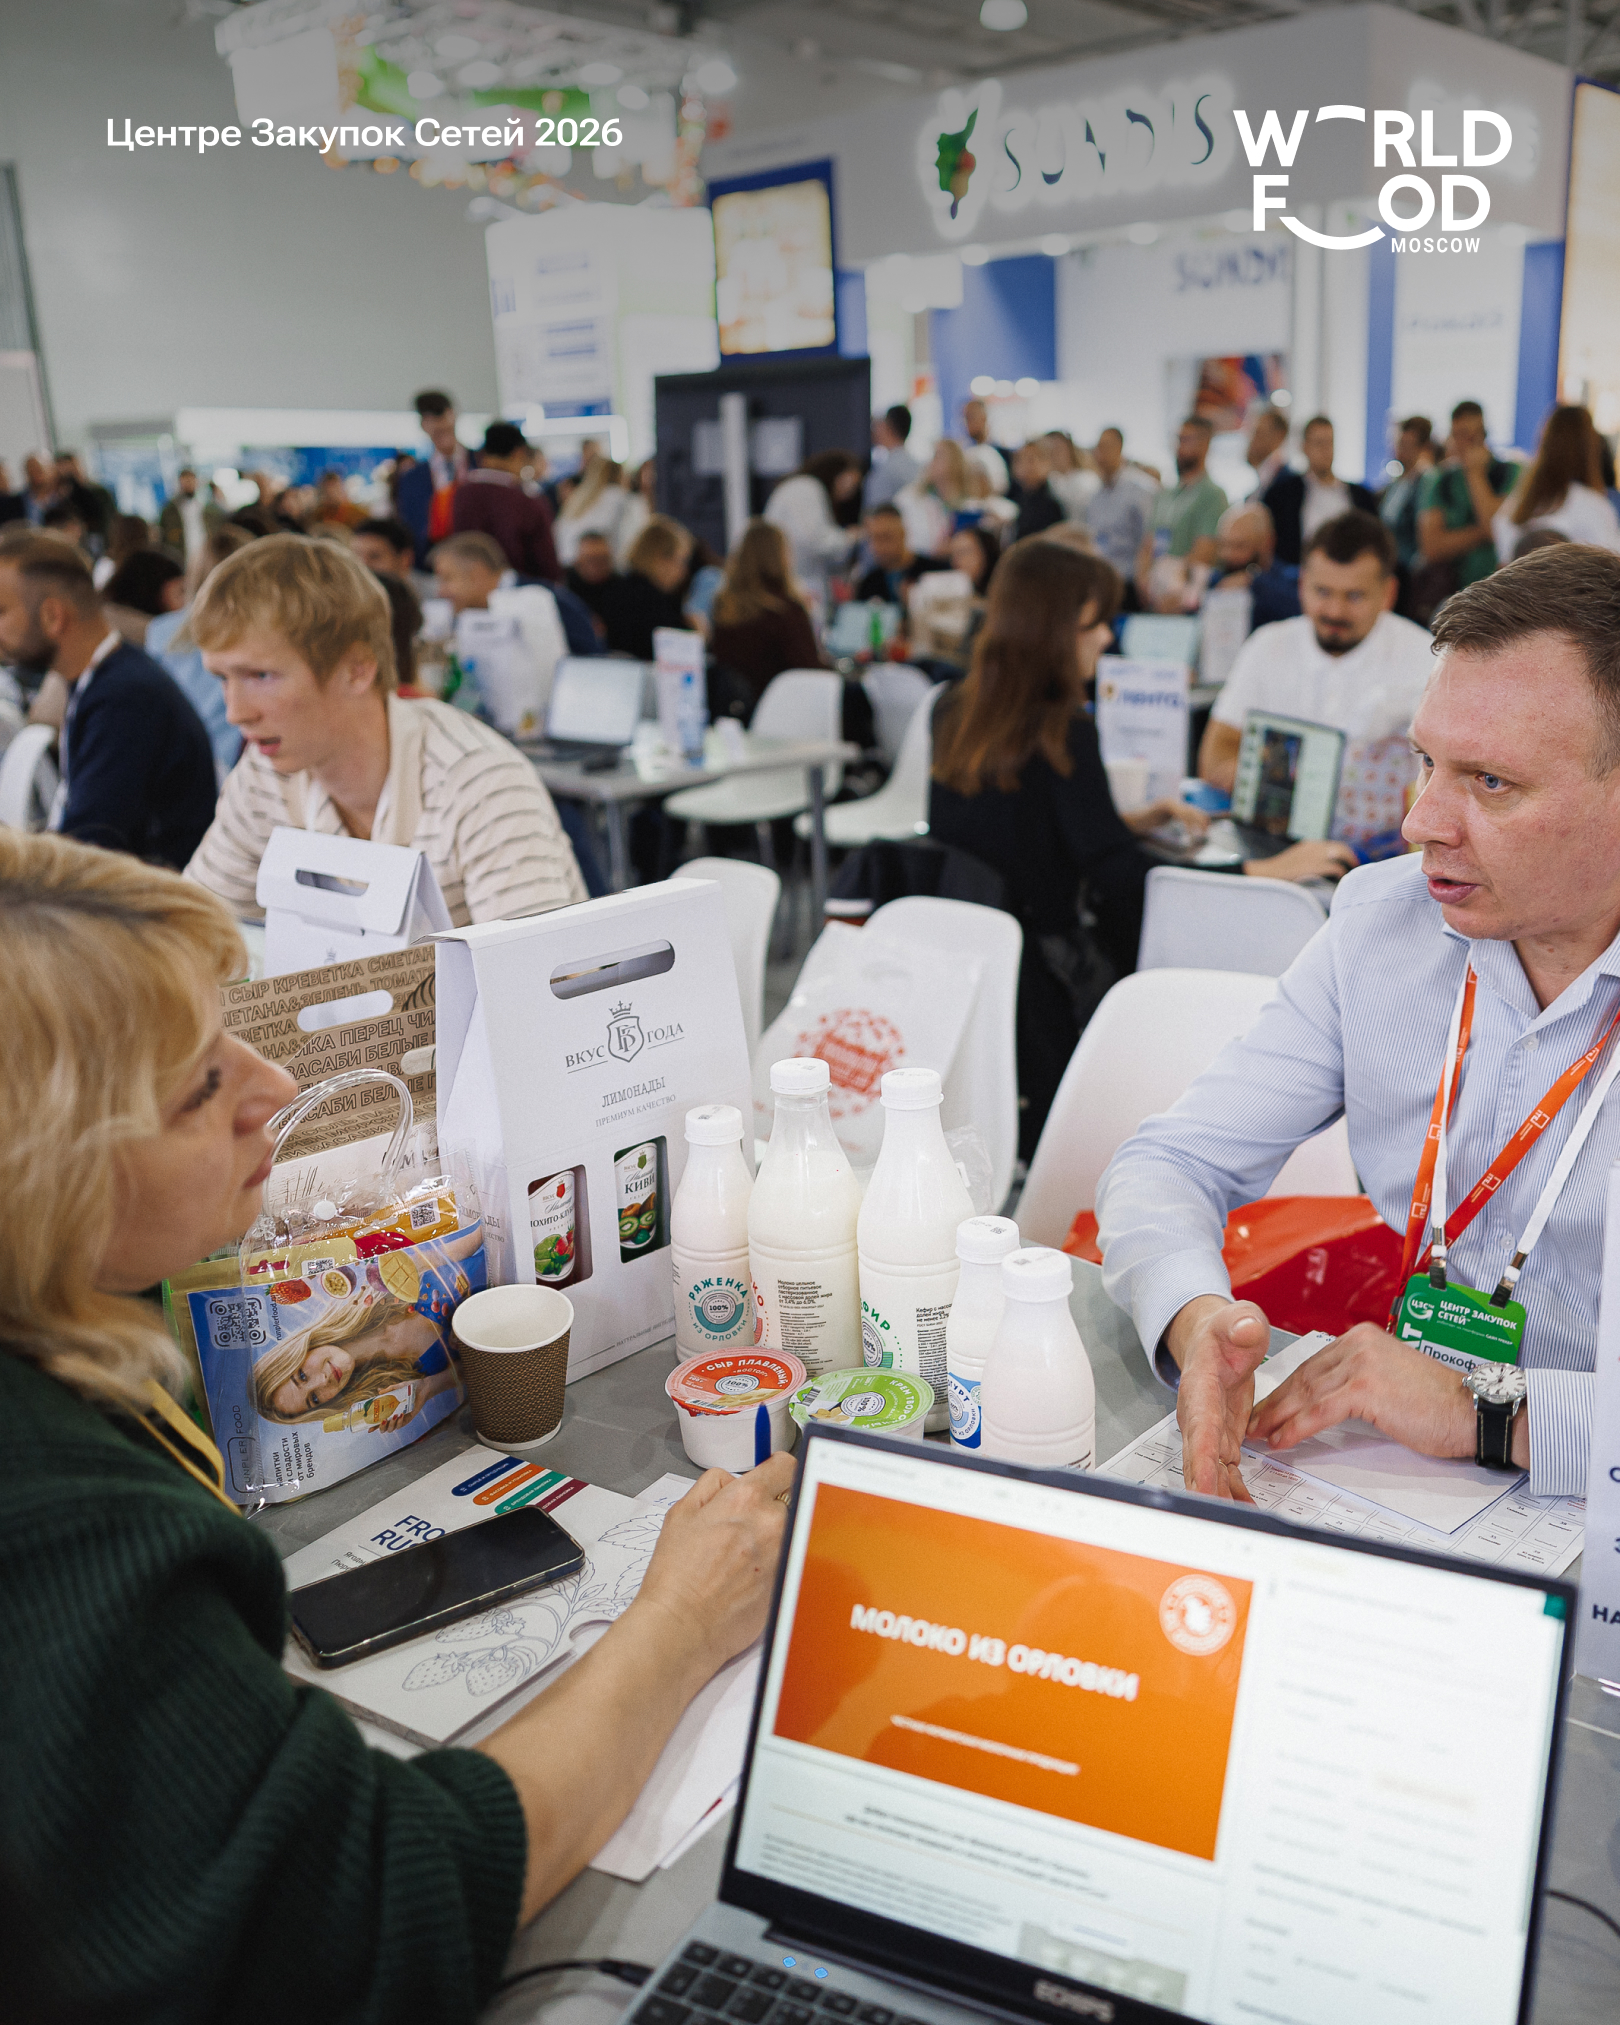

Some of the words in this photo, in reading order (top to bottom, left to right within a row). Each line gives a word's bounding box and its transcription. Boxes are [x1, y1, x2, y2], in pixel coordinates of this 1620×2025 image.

[228, 981, 270, 1005] СЫР
[273, 962, 365, 995] КРЕВЕТКА
[340, 1018, 404, 1047] ПЕРЕЦ
[366, 1032, 429, 1063] БЕЛЫЕ
[565, 1044, 605, 1068] ВКУС
[646, 1022, 684, 1043] ГОДА
[601, 1076, 666, 1108] ЛИМОНАДЫ
[595, 1106, 635, 1128] ПРЕМИУМ
[636, 1093, 677, 1115] КАЧЕСТВО
[624, 1171, 656, 1195] КИВИ
[688, 1277, 750, 1302] РЯЖЕНКА
[708, 1304, 729, 1313] 100%
[1439, 1300, 1470, 1315] ЦЕНТР
[1471, 1310, 1517, 1331] ЗАКУПОК
[693, 1321, 703, 1334] ИЗ
[704, 1319, 748, 1342] ОРЛОВКИ
[706, 1361, 733, 1371] СЫР
[738, 1359, 789, 1386] ПЛАВЛЕНЫЙ
[726, 1380, 748, 1388] 100%
[232, 1404, 244, 1434] FOOD
[281, 1437, 294, 1477] сладости
[291, 1431, 303, 1470] мировых
[303, 1442, 316, 1479] брендов
[297, 1471, 304, 1482] от
[370, 1529, 426, 1551] RU
[850, 1602, 967, 1657] МОЛОКО
[967, 1632, 1007, 1667] ИЗ
[1006, 1643, 1142, 1703] ОРЛОВКИ
